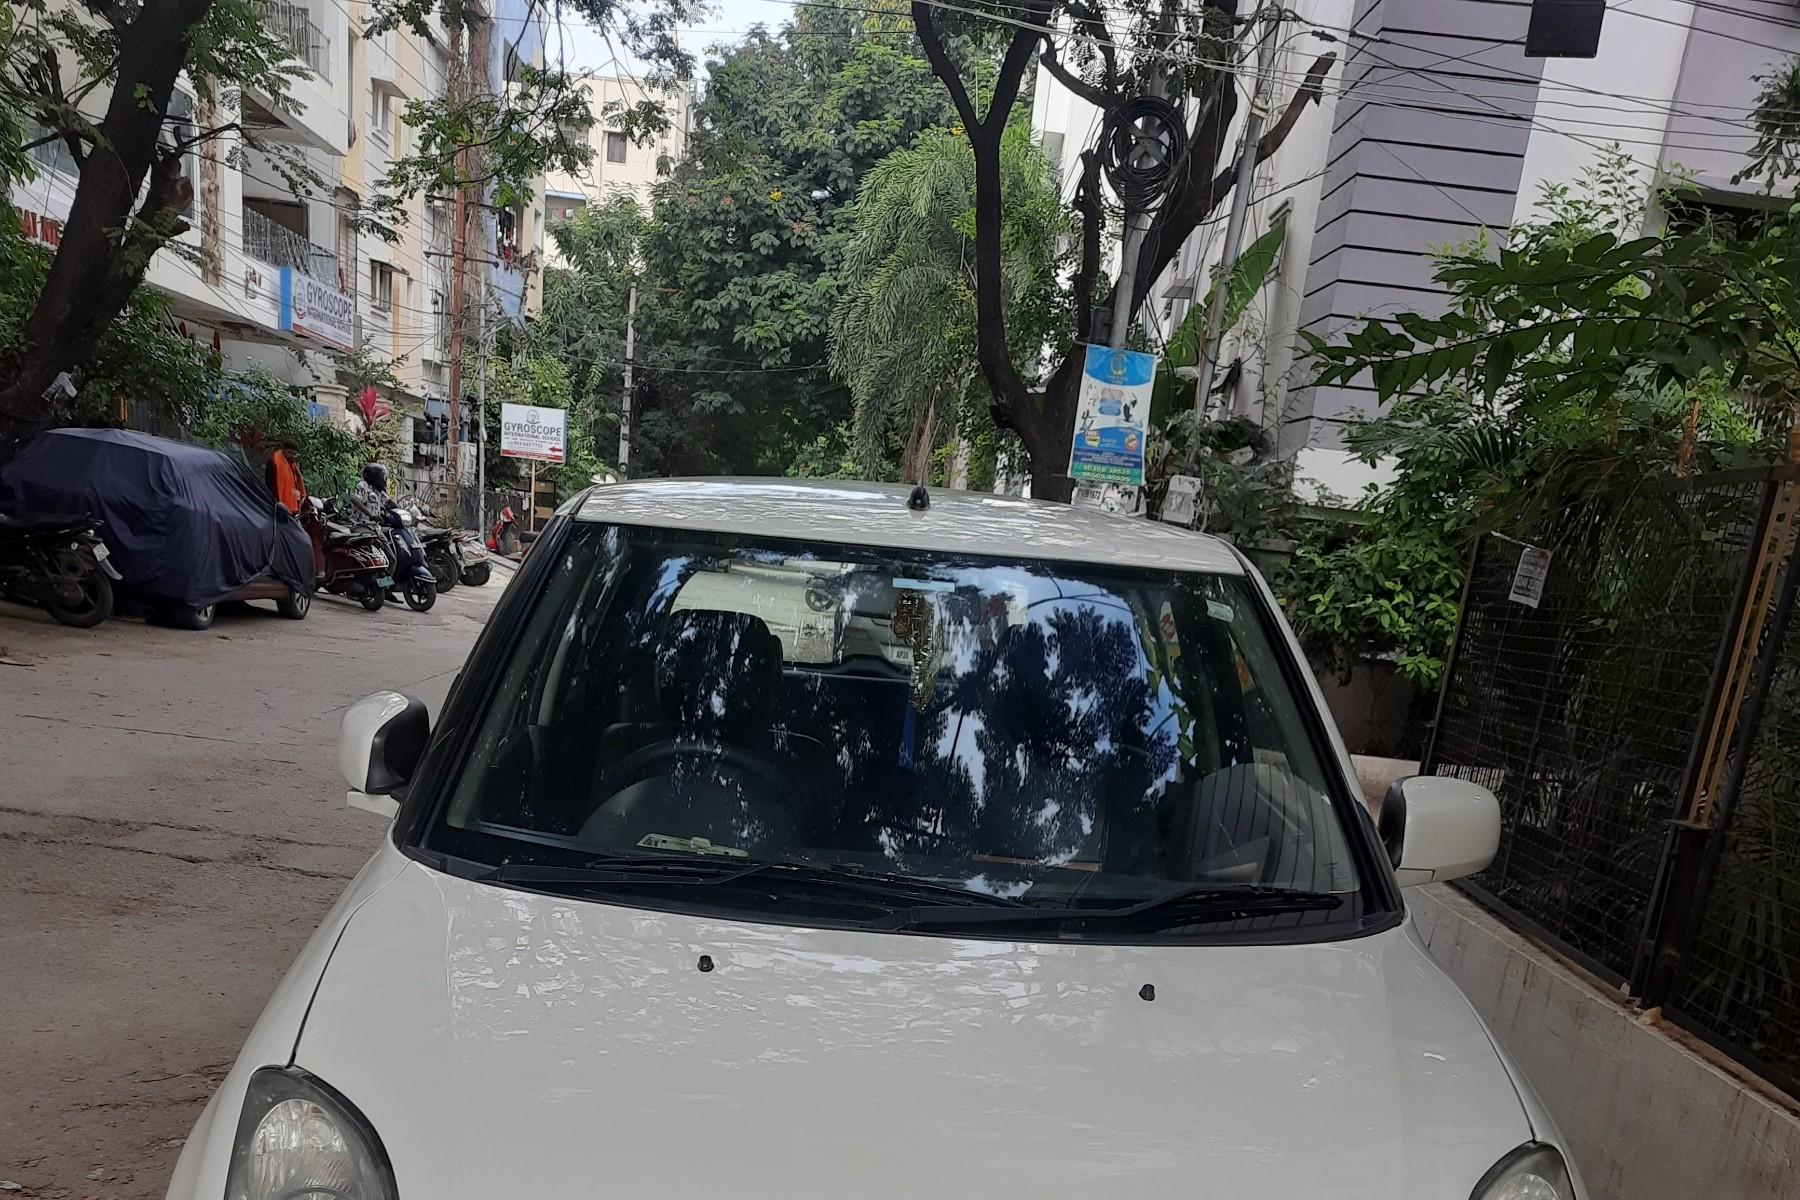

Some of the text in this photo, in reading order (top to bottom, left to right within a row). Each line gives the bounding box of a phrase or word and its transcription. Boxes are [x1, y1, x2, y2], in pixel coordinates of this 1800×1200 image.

[306, 282, 352, 323] GYROSCOPE
[504, 422, 562, 436] GYROSCOPE
[504, 431, 541, 439] INTERNATIONAL
